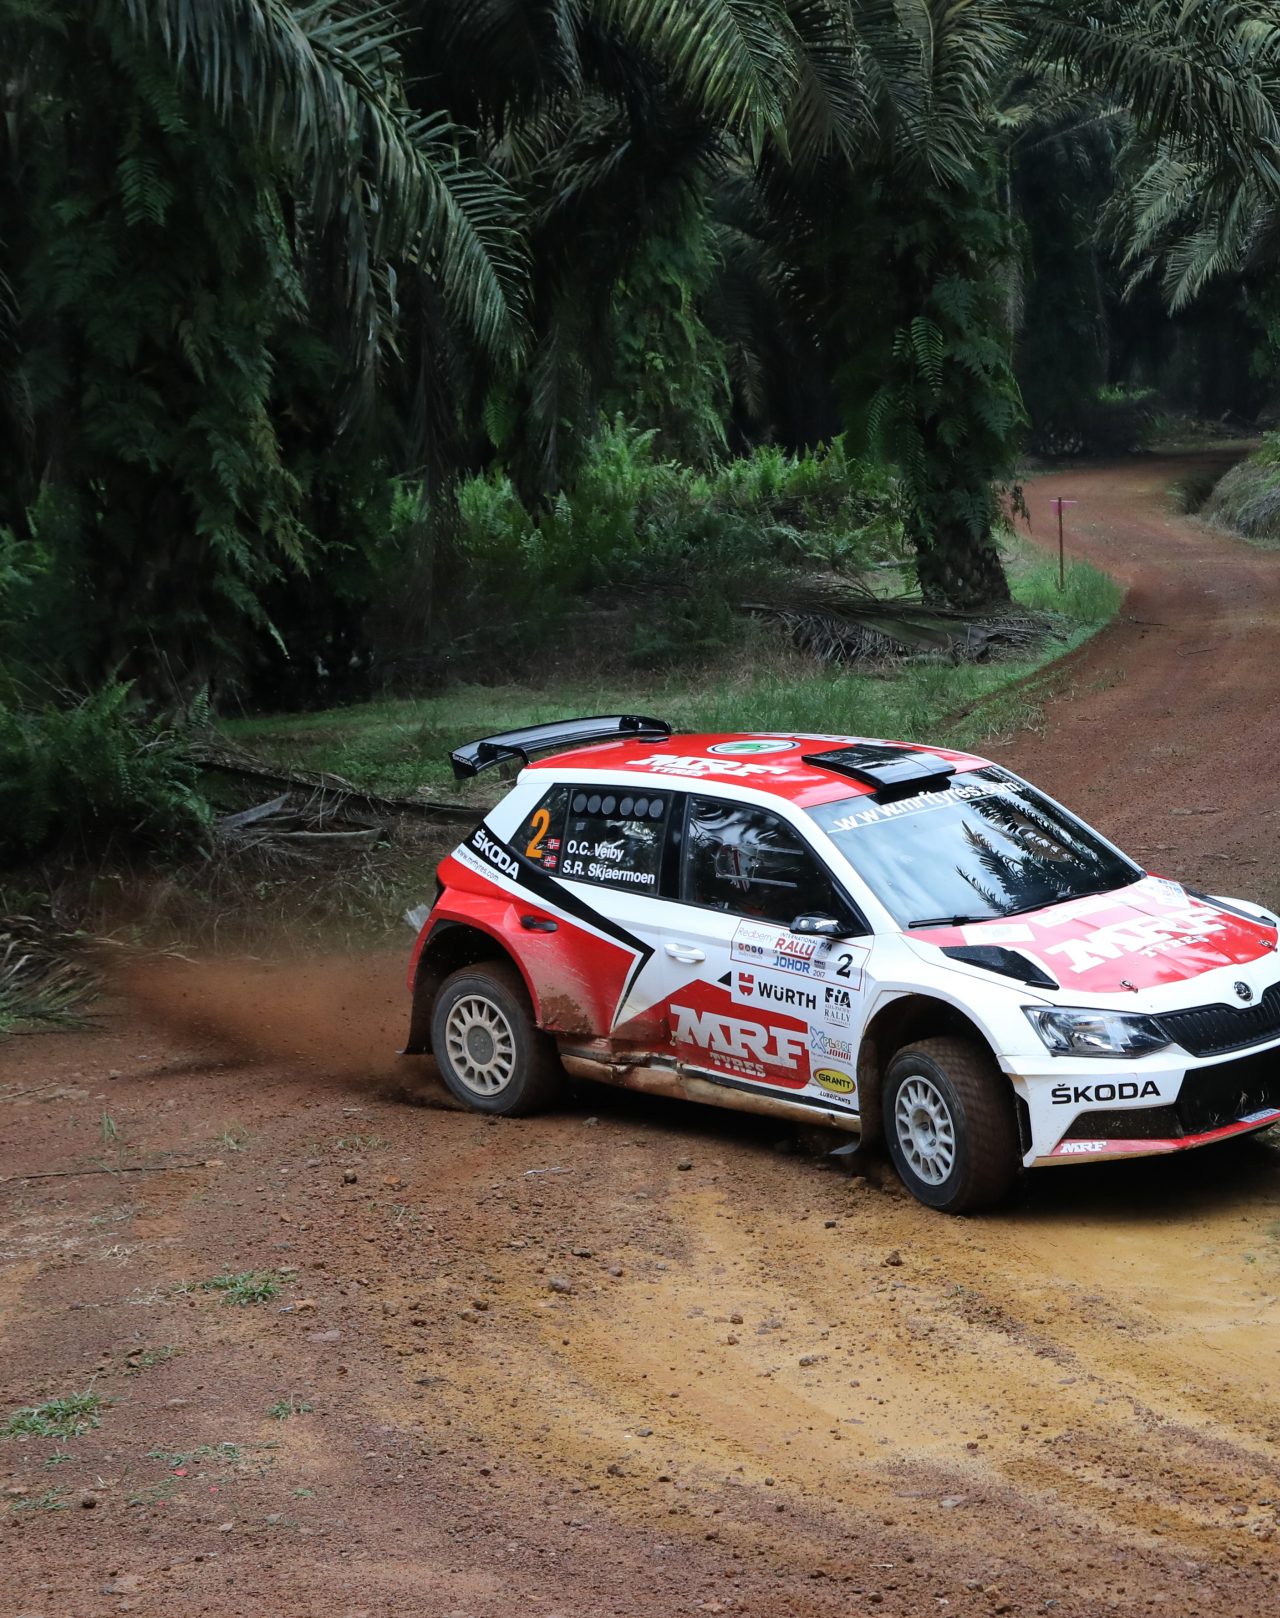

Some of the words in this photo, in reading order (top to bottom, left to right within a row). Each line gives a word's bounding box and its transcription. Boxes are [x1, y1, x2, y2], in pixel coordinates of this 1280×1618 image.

[625, 754, 789, 777] MRF
[525, 808, 551, 858] 2
[472, 829, 520, 880] ŠKODA
[567, 840, 591, 856] O.C.
[594, 843, 625, 862] Veiby
[562, 860, 585, 876] S.R.
[587, 862, 655, 885] Skjaermoen
[774, 938, 817, 957] RALLY
[1043, 907, 1228, 974] MRF
[773, 955, 811, 974] JOHOR
[812, 970, 826, 978] 2017
[836, 953, 853, 979] 2
[758, 981, 817, 1010] WÜRTH
[824, 1008, 851, 1022] RALLY
[669, 1004, 809, 1069] MRF
[710, 1052, 766, 1078] TYRES
[818, 1073, 851, 1089] GRANTT
[820, 1090, 851, 1105] LUBRICANTS
[1051, 1081, 1161, 1105] ŠKODA
[1060, 1141, 1106, 1154] MRF
